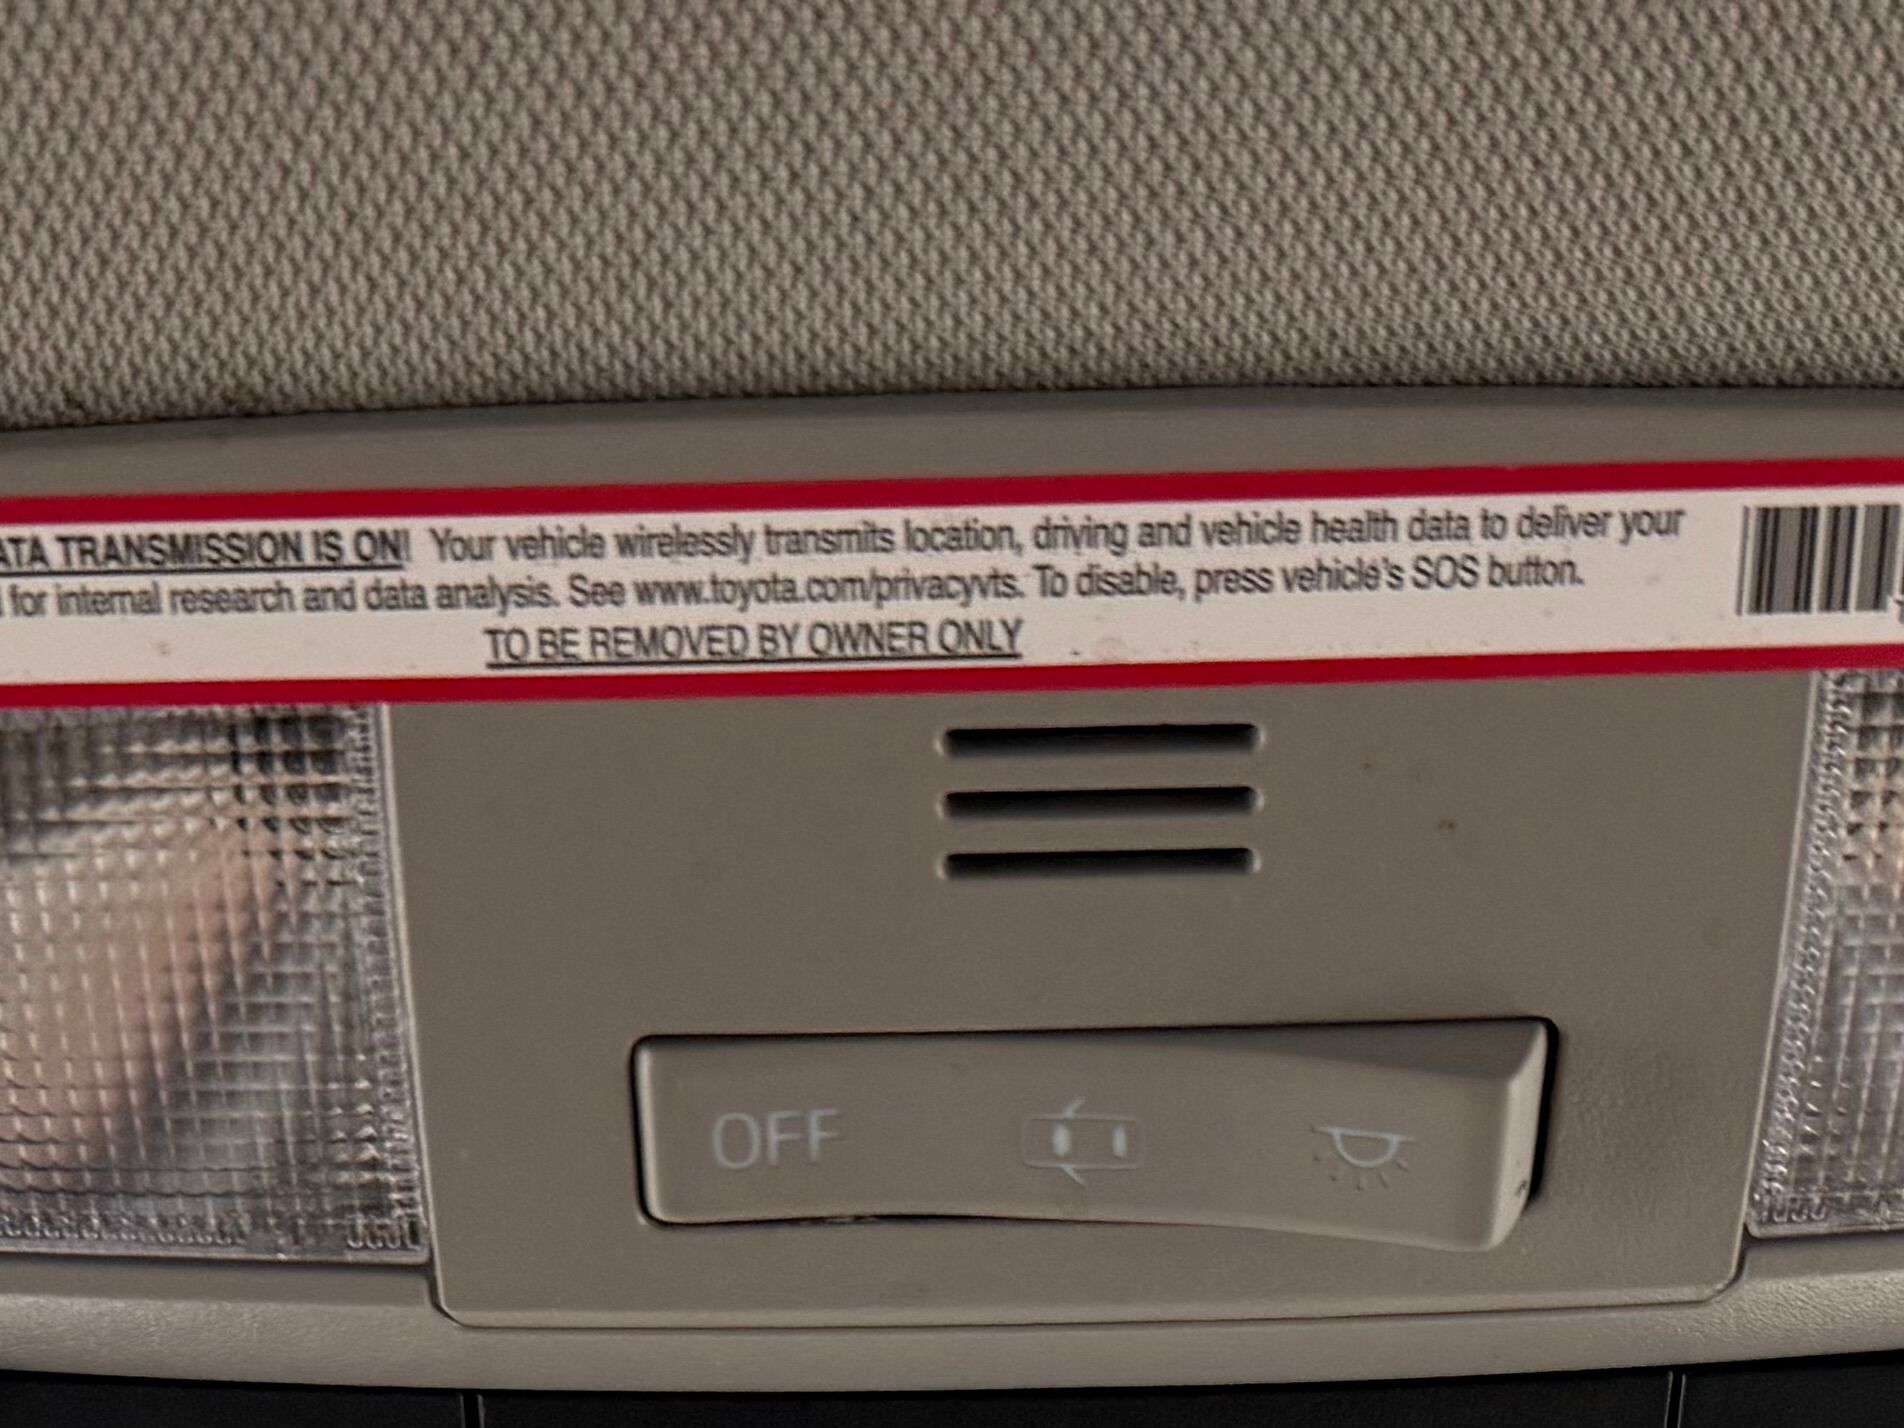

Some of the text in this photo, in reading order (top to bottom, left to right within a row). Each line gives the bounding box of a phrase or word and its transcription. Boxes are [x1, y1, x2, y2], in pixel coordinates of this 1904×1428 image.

[54, 529, 303, 568] TRANSMISSION
[313, 528, 345, 563] IS
[353, 527, 411, 563] ON!
[429, 526, 497, 562] Your
[502, 523, 607, 561] vehicle
[612, 523, 756, 565] wirelessly
[764, 520, 895, 555] transmits
[903, 517, 1024, 556] location,
[1032, 514, 1128, 556] driving
[1137, 511, 1193, 548] and
[1199, 510, 1301, 547] vehicle
[1310, 508, 1398, 545] health
[1407, 507, 1472, 543] data
[1479, 506, 1509, 541] to
[1516, 504, 1612, 540] deliver
[1619, 507, 1686, 546] your
[9, 583, 48, 618] for
[54, 580, 162, 617] internal
[169, 580, 294, 615] research
[303, 578, 356, 612] and
[364, 576, 429, 611] data
[435, 573, 561, 618] analysis.
[568, 571, 627, 608] See
[1031, 563, 1070, 600] To
[1075, 562, 1186, 602] disable,
[1194, 564, 1274, 604] press
[1281, 555, 1405, 595] vehicle's
[1411, 553, 1481, 592] SOS
[1487, 552, 1585, 590] button.
[483, 616, 1024, 662] TO BE REMOVED BY OWNER ONLY
[710, 1107, 844, 1170] OFF
